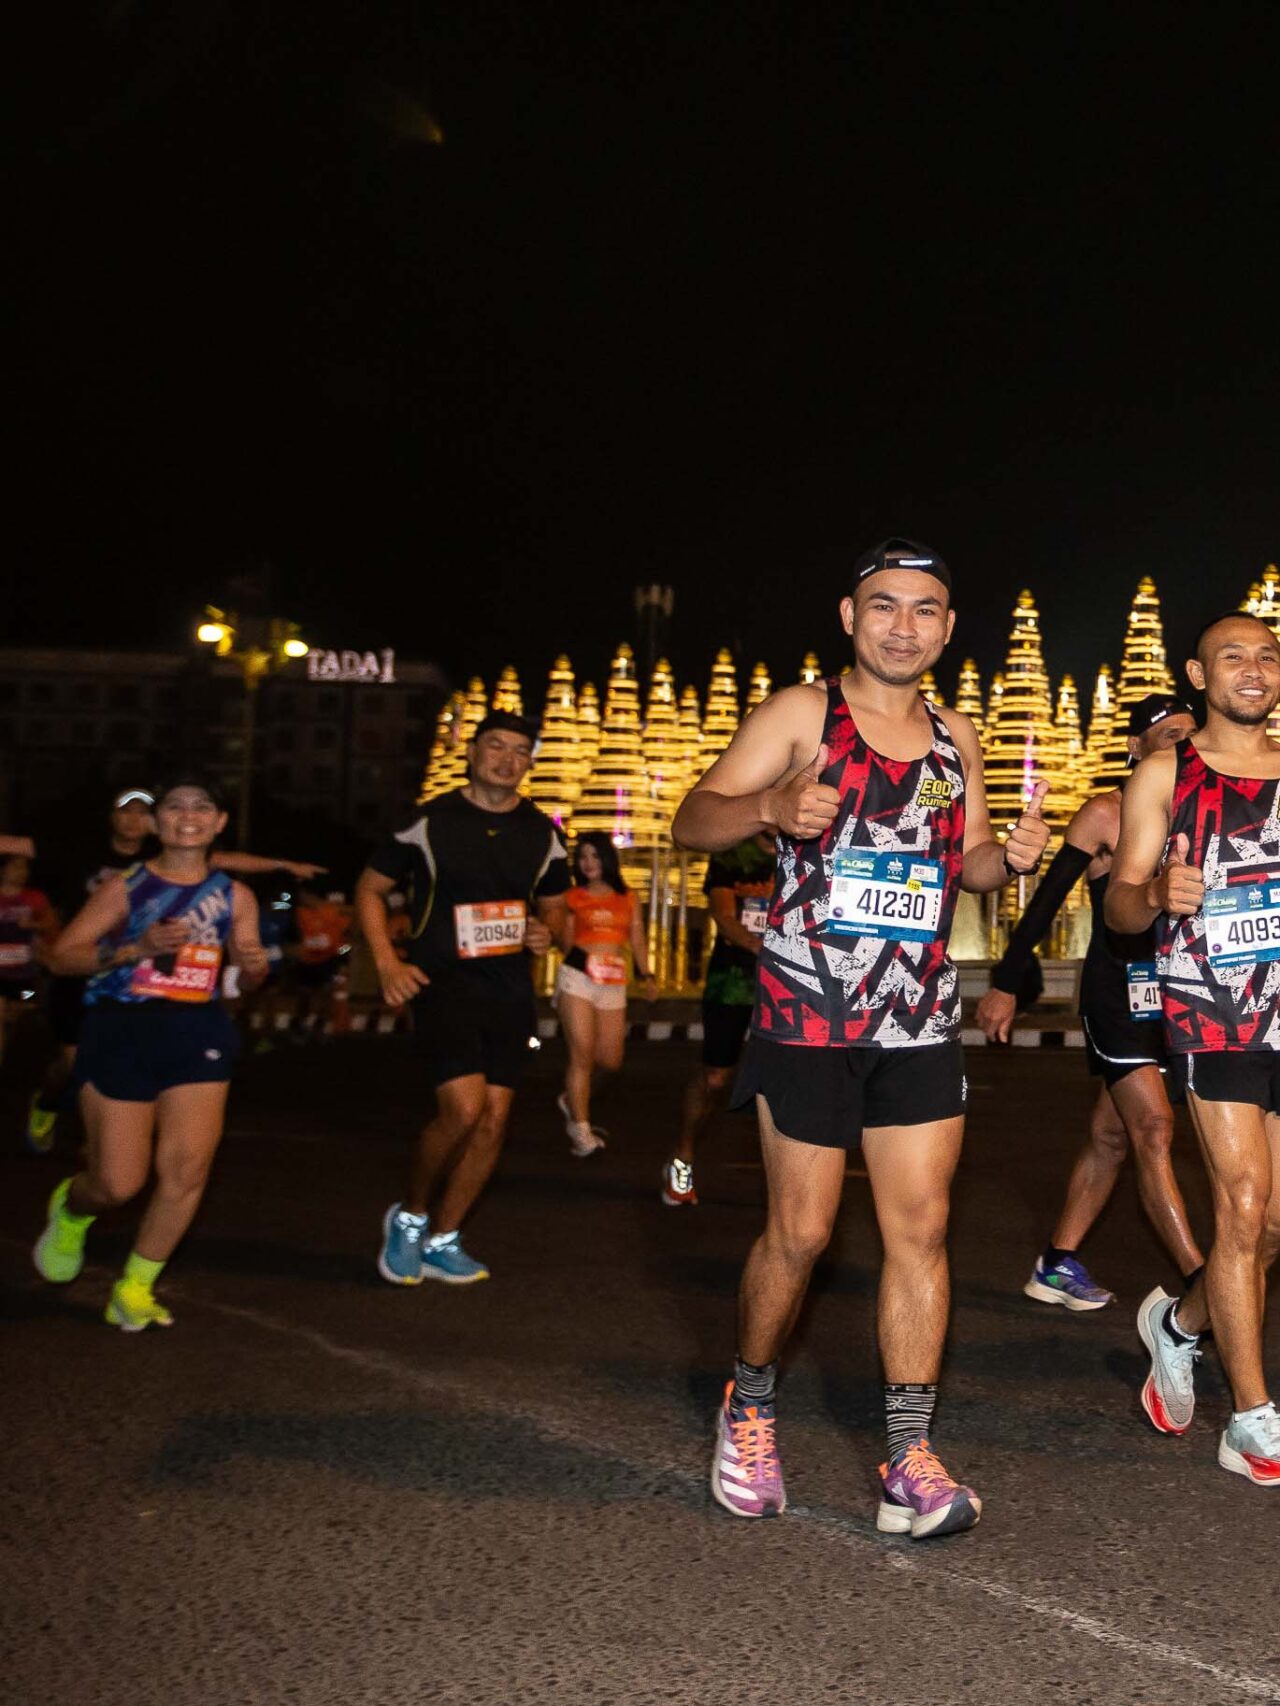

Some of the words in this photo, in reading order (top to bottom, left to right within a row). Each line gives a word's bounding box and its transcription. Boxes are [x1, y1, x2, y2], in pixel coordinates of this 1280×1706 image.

[920, 779, 952, 796] EOD
[917, 795, 952, 809] Runner
[856, 888, 926, 920] 41230
[473, 924, 519, 942] 20942
